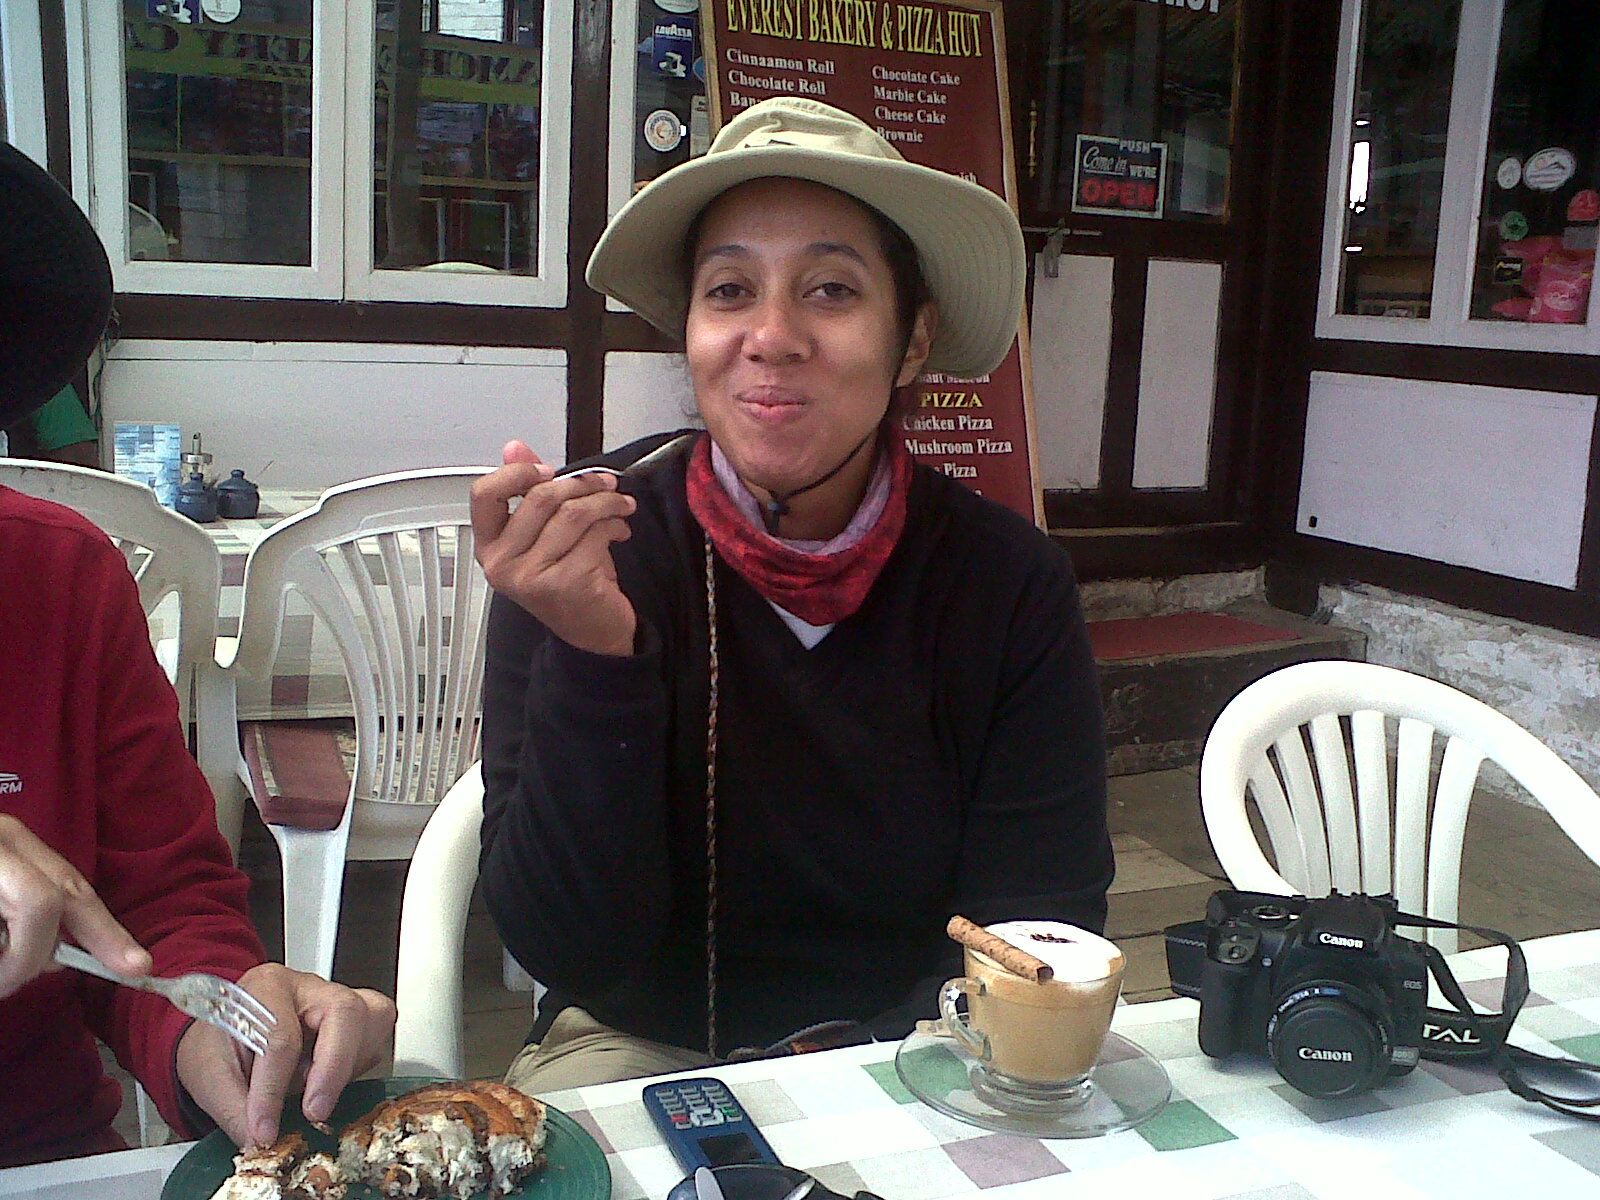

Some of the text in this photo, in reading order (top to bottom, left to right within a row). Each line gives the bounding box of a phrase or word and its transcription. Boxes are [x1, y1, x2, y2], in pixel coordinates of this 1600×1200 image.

[727, 0, 982, 57] EVEREST BAKERY & PIZZA HUT
[726, 48, 835, 75] Cinnaamon Roll
[728, 69, 826, 95] Chocolate Roll
[872, 65, 961, 86] Chocolate Cake
[873, 85, 947, 105] Marble Cake
[874, 105, 947, 124] Cheese Cake
[877, 126, 924, 143] Brownie
[1120, 140, 1150, 153] PUSH
[1083, 146, 1114, 171] Come
[1082, 178, 1157, 207] OPEN
[920, 392, 984, 408] PIZZA
[958, 414, 993, 431] Pizza
[904, 438, 1013, 455] Mushroom Pizza
[944, 462, 978, 478] Pizza
[1320, 933, 1363, 949] Canon
[1299, 1047, 1352, 1062] Canon
